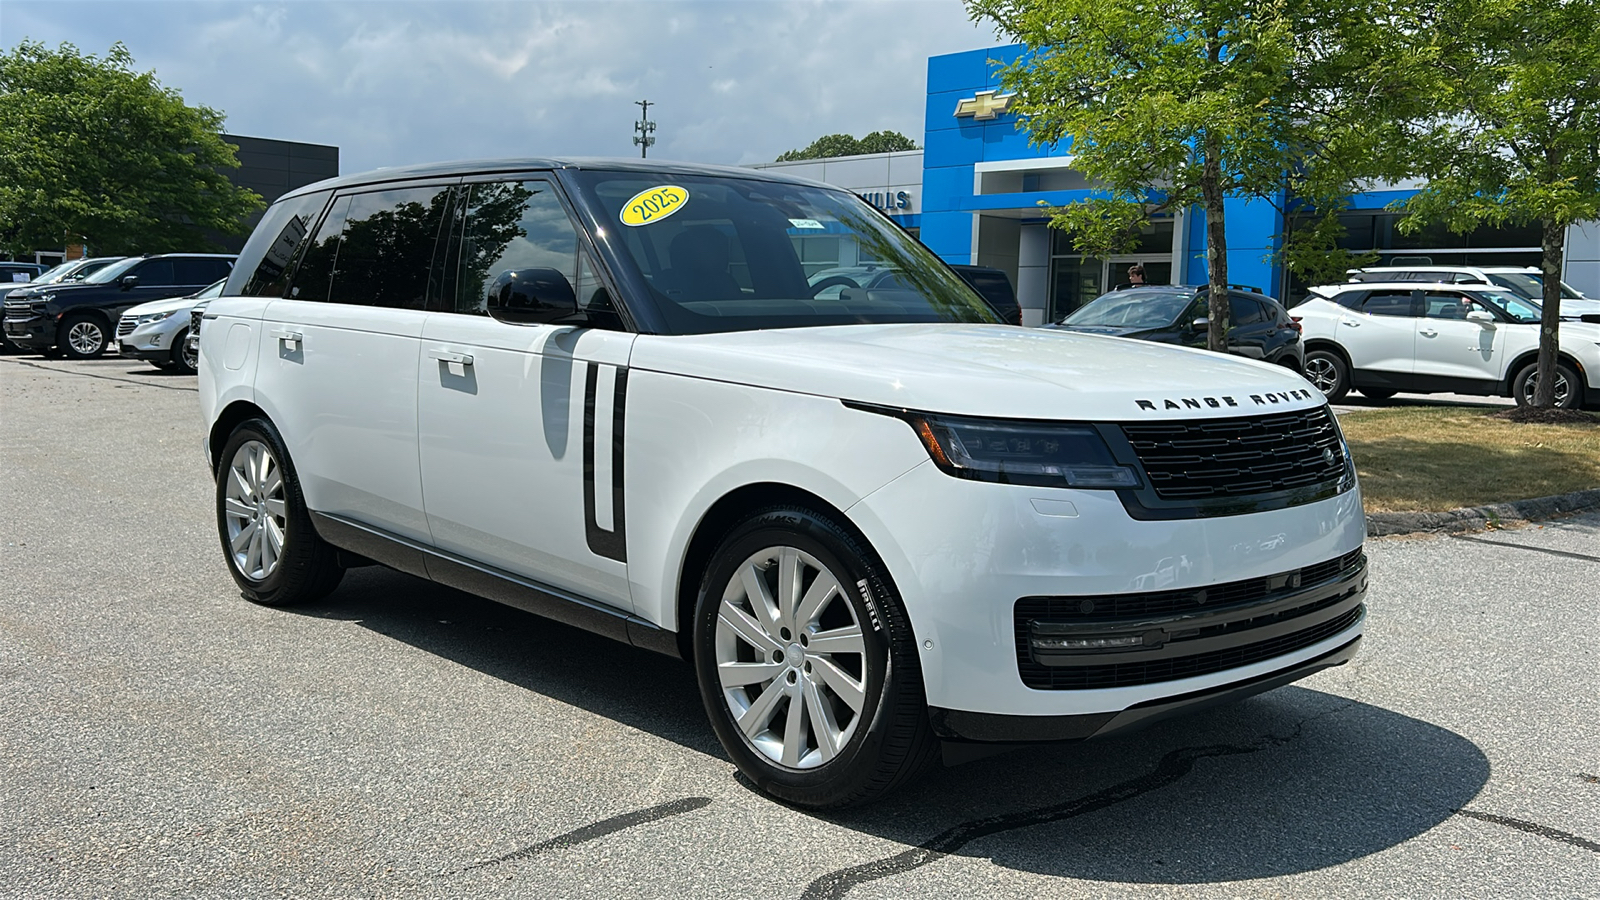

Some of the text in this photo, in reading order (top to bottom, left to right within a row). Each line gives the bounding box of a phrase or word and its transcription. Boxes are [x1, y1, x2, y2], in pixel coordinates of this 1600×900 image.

[632, 188, 680, 221] 2025
[863, 191, 907, 209] ILLS
[1134, 388, 1313, 411] RANGE ROVER
[856, 578, 883, 632] PIRELLI
